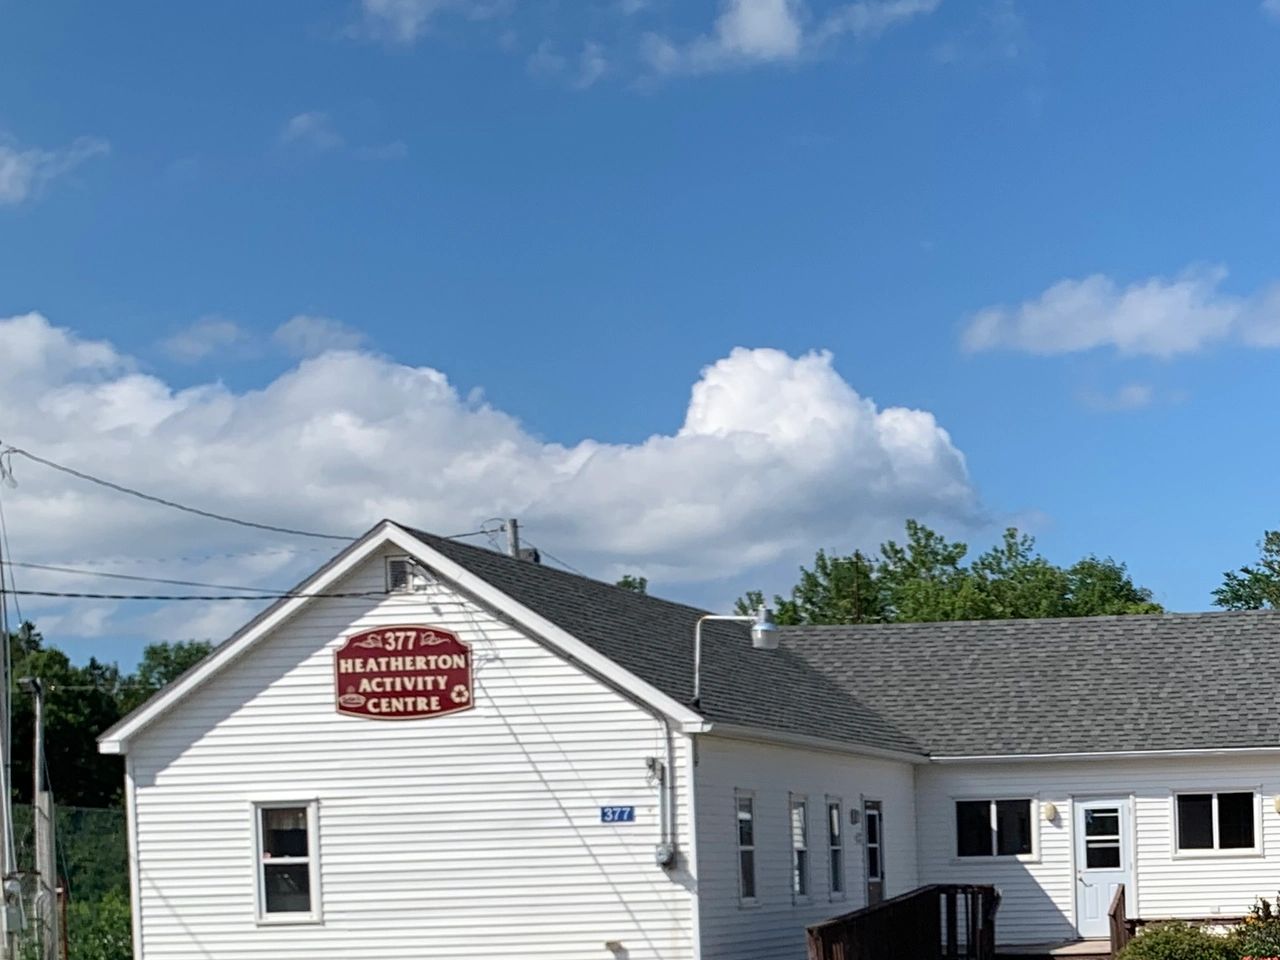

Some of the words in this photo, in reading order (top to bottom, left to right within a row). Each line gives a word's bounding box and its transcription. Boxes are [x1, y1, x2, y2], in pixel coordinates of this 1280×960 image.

[384, 631, 416, 650] 377
[339, 654, 466, 673] HEATHERTON
[358, 675, 448, 693] ACTIVITY
[367, 696, 441, 713] CENTRE
[603, 807, 631, 821] 377
